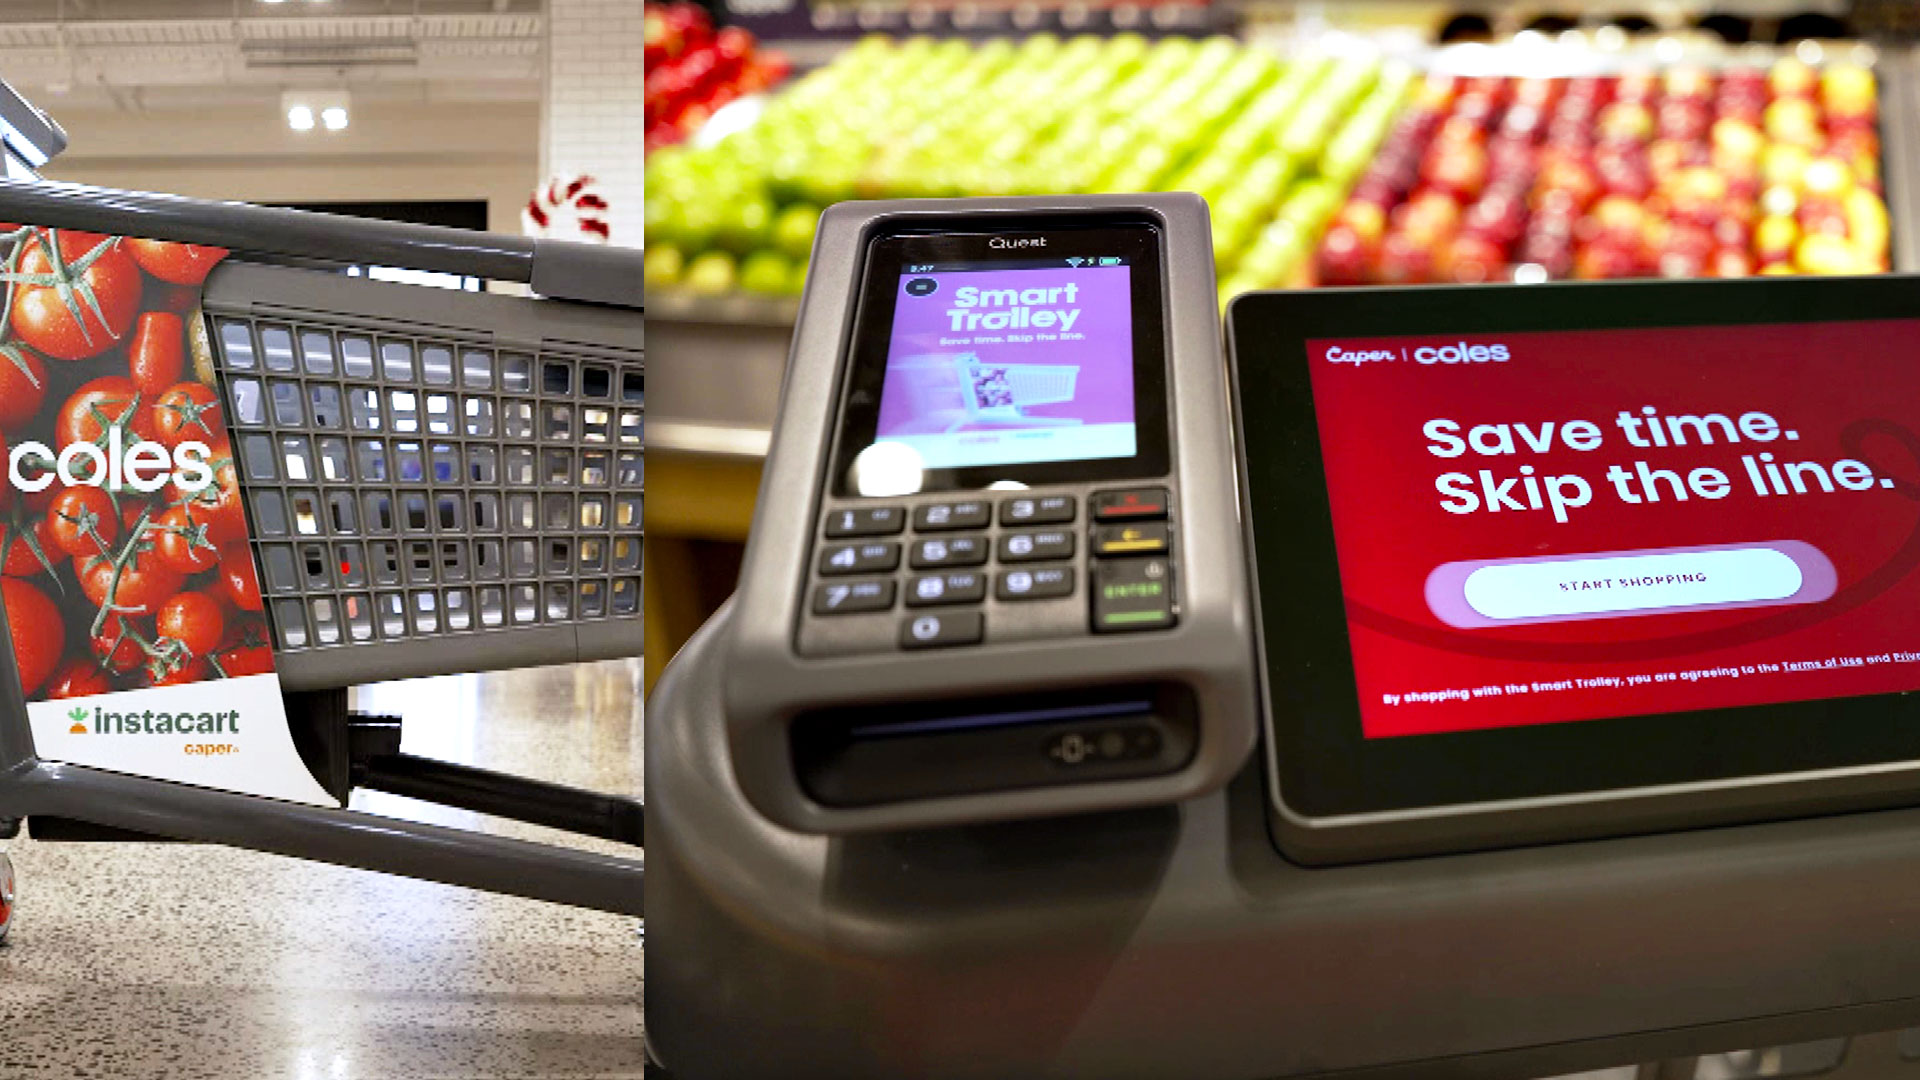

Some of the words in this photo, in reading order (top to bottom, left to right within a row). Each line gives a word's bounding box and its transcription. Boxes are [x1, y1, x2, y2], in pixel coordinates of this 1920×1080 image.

[989, 237, 1047, 249] Quest
[954, 282, 1079, 308] Smart
[946, 307, 1081, 332] Trolley
[939, 336, 971, 346] Save
[974, 335, 1005, 345] time.
[1007, 333, 1034, 345] Skip
[1037, 332, 1058, 341] the
[1060, 331, 1086, 341] line.
[1326, 346, 1396, 367] Caper
[1414, 341, 1511, 364] coles
[1423, 418, 1603, 458] Save
[1616, 406, 1800, 447] time.
[8, 425, 213, 493] coles
[1435, 464, 1593, 523] Skip
[1607, 461, 1731, 504] the
[1742, 452, 1895, 496] line.
[830, 548, 856, 567] 4
[1559, 578, 1611, 591] START
[1619, 572, 1706, 588] SHOPPING
[1383, 694, 1400, 706] By
[1404, 688, 1470, 703] shopping
[1472, 685, 1502, 698] with
[1505, 684, 1528, 694] the
[1531, 679, 1572, 693] Smart
[1575, 676, 1625, 688] Trolley,
[1627, 674, 1652, 686] you
[1655, 671, 1676, 682] are
[1680, 666, 1740, 682] agreeing
[1741, 665, 1756, 675] to
[1758, 663, 1779, 673] the
[1782, 660, 1822, 671] Terms
[1825, 657, 1837, 668] of
[1839, 656, 1864, 667] Use
[1866, 653, 1891, 664] and
[94, 707, 239, 734] instacart
[184, 744, 233, 757] caper
